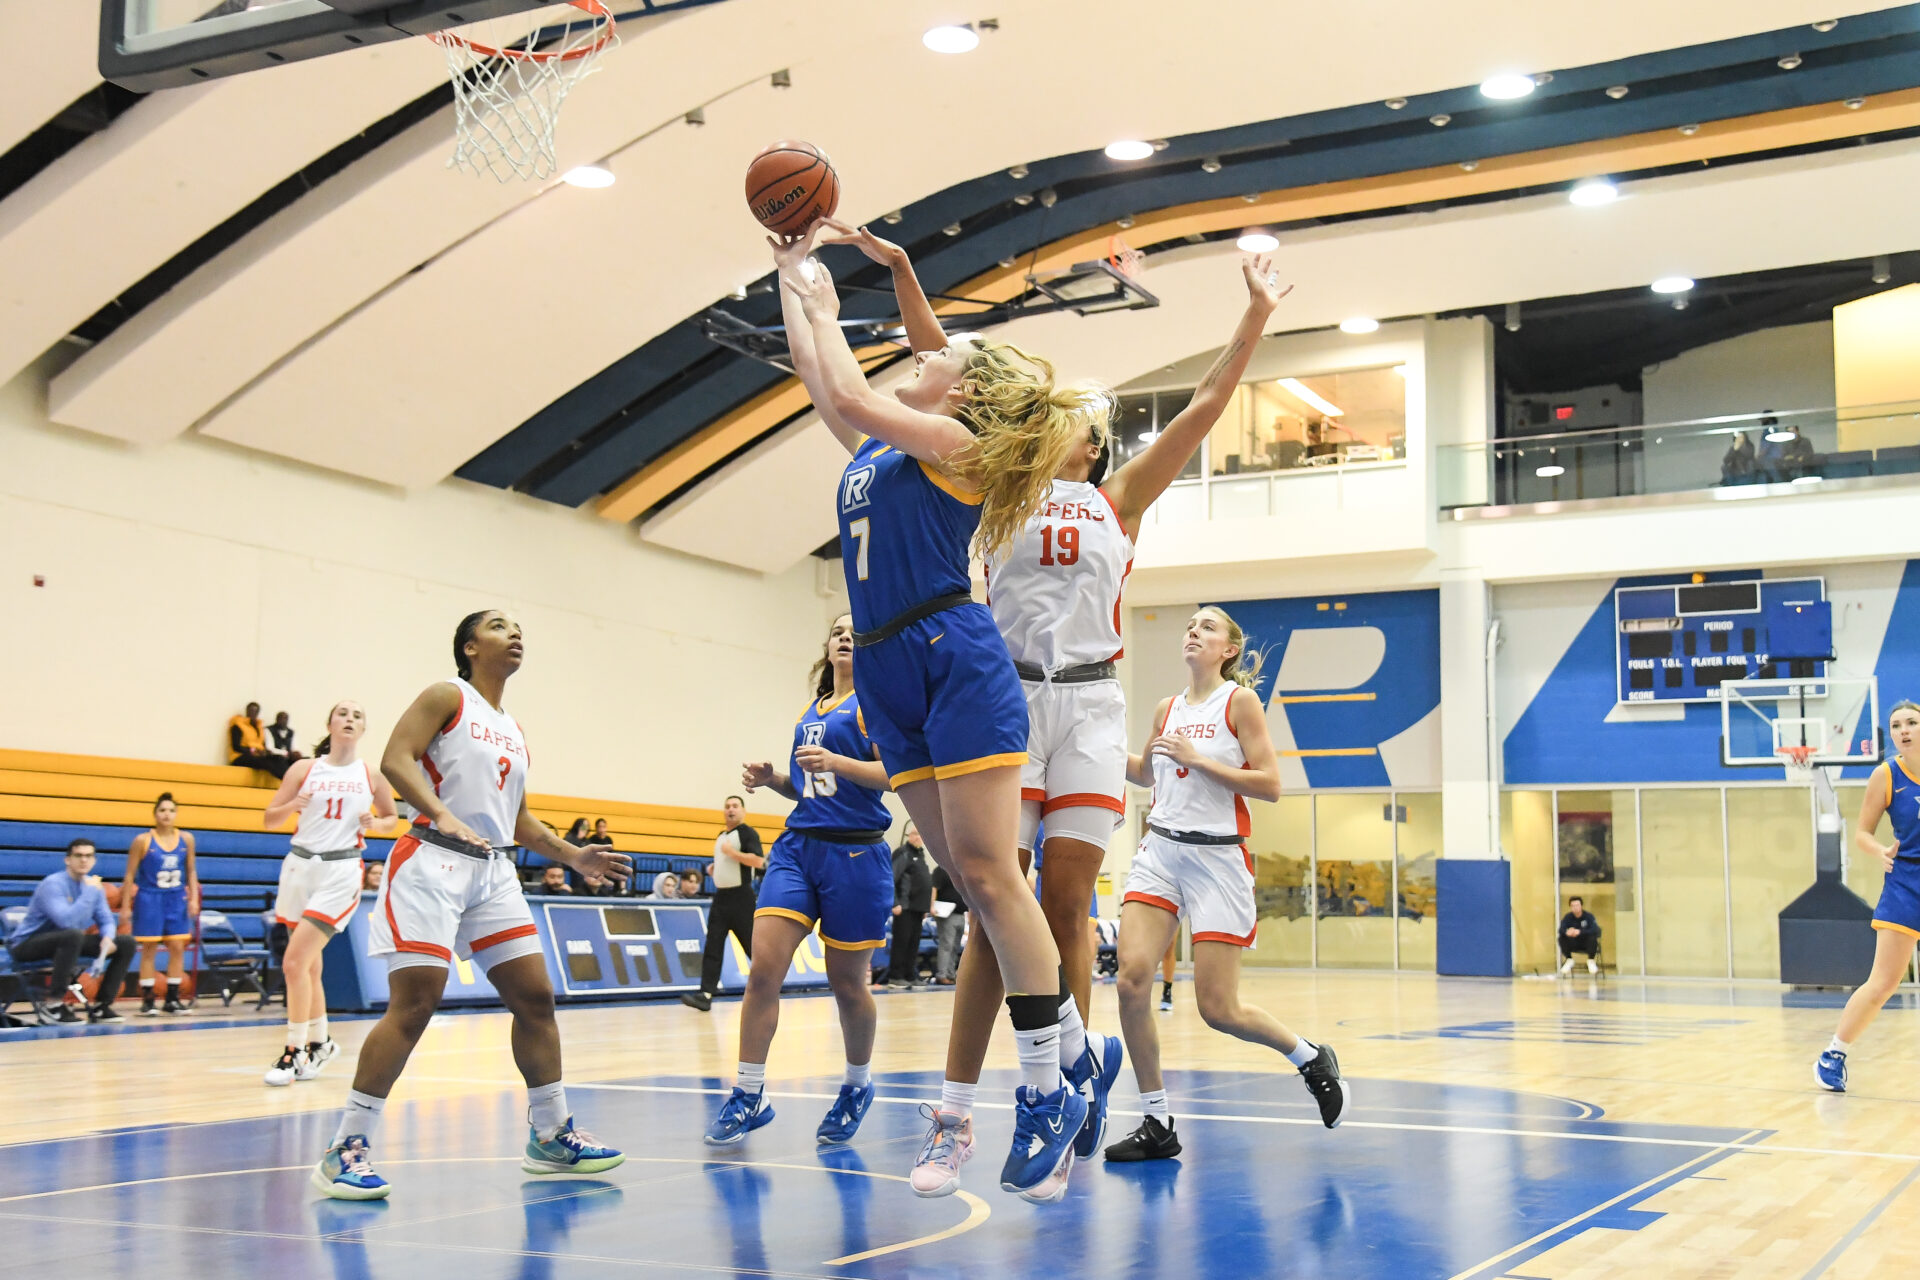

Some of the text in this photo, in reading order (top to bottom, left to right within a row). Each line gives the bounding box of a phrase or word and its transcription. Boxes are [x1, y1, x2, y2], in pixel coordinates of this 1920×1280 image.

[752, 184, 807, 221] Wilson
[1041, 502, 1105, 521] PERS
[849, 516, 870, 581] 7
[1039, 524, 1080, 567] 19
[1703, 621, 1734, 631] PERIOD
[1628, 659, 1655, 669] FOULS
[1691, 655, 1748, 667] PLAYER FOUL
[1628, 691, 1655, 700] SCORE
[1788, 684, 1817, 696] SCRE
[309, 780, 364, 794] CAPERS
[323, 797, 345, 820] 11
